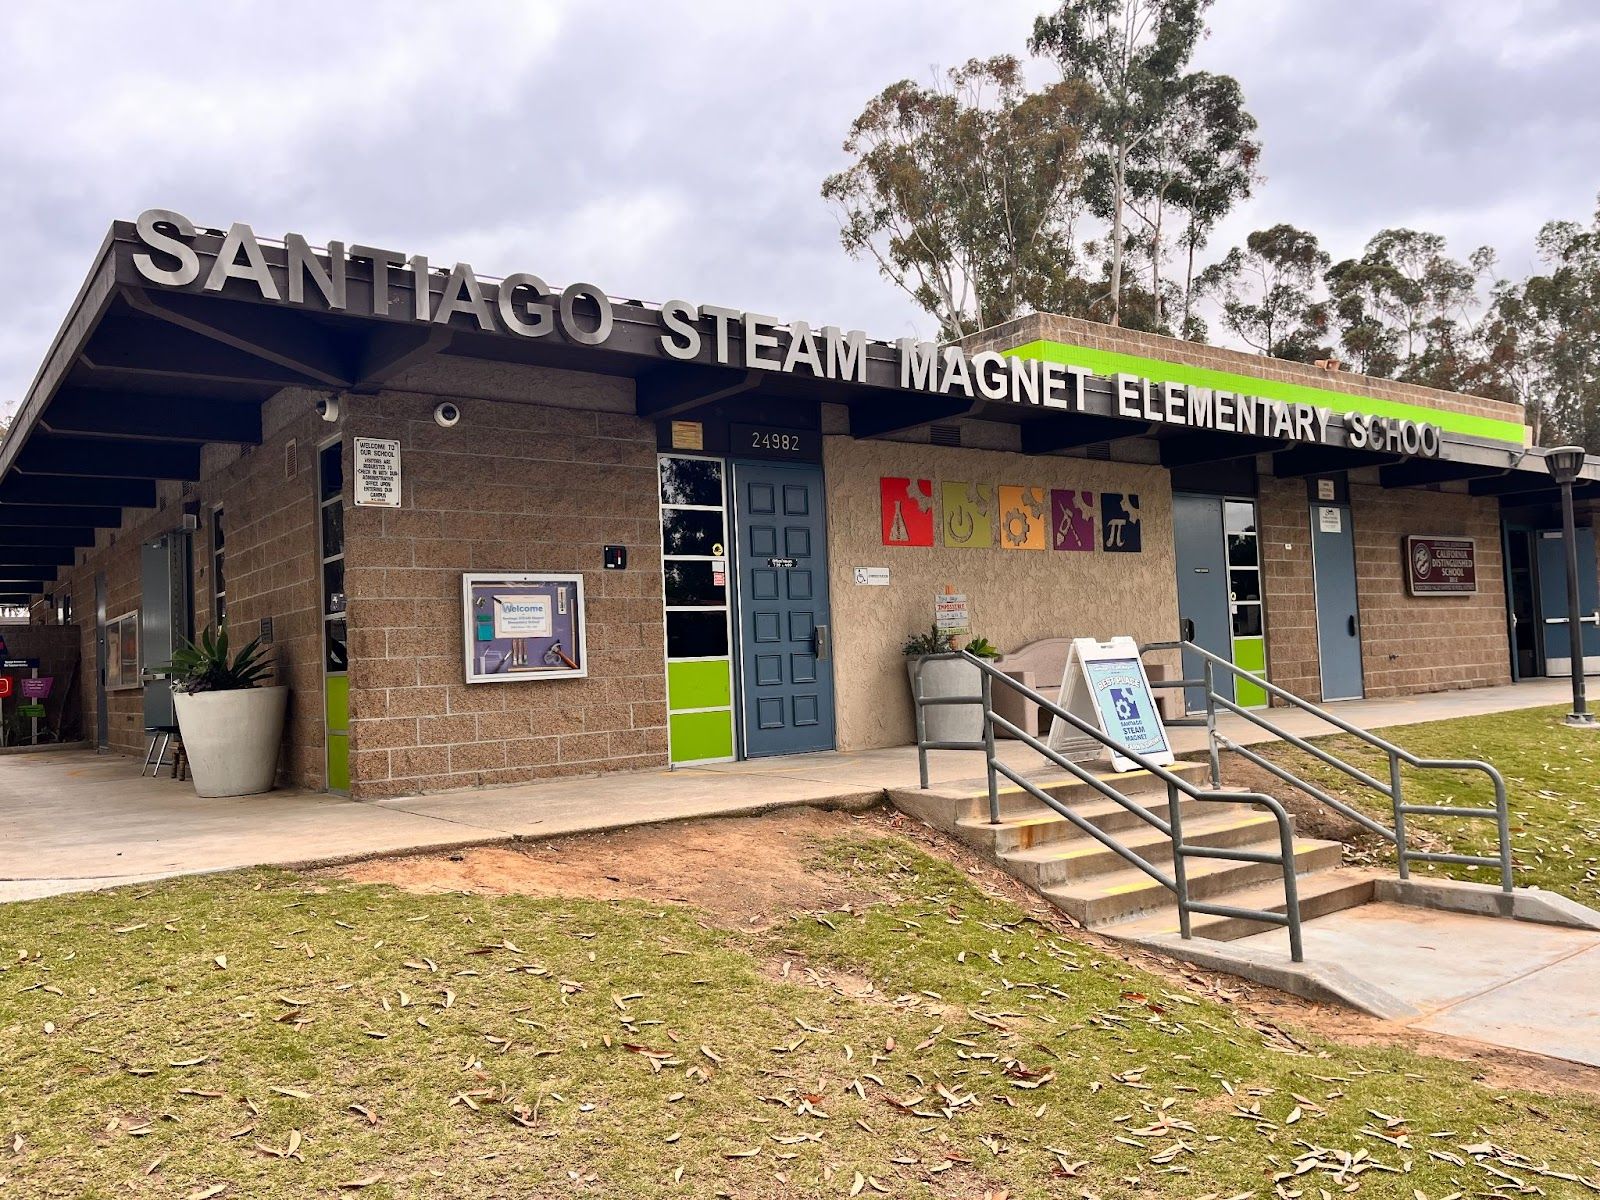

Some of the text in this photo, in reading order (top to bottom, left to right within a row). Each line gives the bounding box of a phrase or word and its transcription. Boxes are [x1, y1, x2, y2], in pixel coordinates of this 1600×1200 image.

[133, 209, 614, 345] SANTIAGO
[660, 300, 867, 383] STEAM
[896, 338, 1093, 411] MAGNET
[1112, 372, 1331, 443] ELEMENTARY
[752, 432, 800, 451] 24982
[360, 442, 385, 450] WELCOME
[1436, 549, 1468, 558] CALIFORNIA
[1432, 559, 1472, 567] DISTINGUISHED
[1442, 568, 1464, 576] SCHOOL
[503, 604, 544, 613] Welcome
[1123, 726, 1145, 734] STEAM
